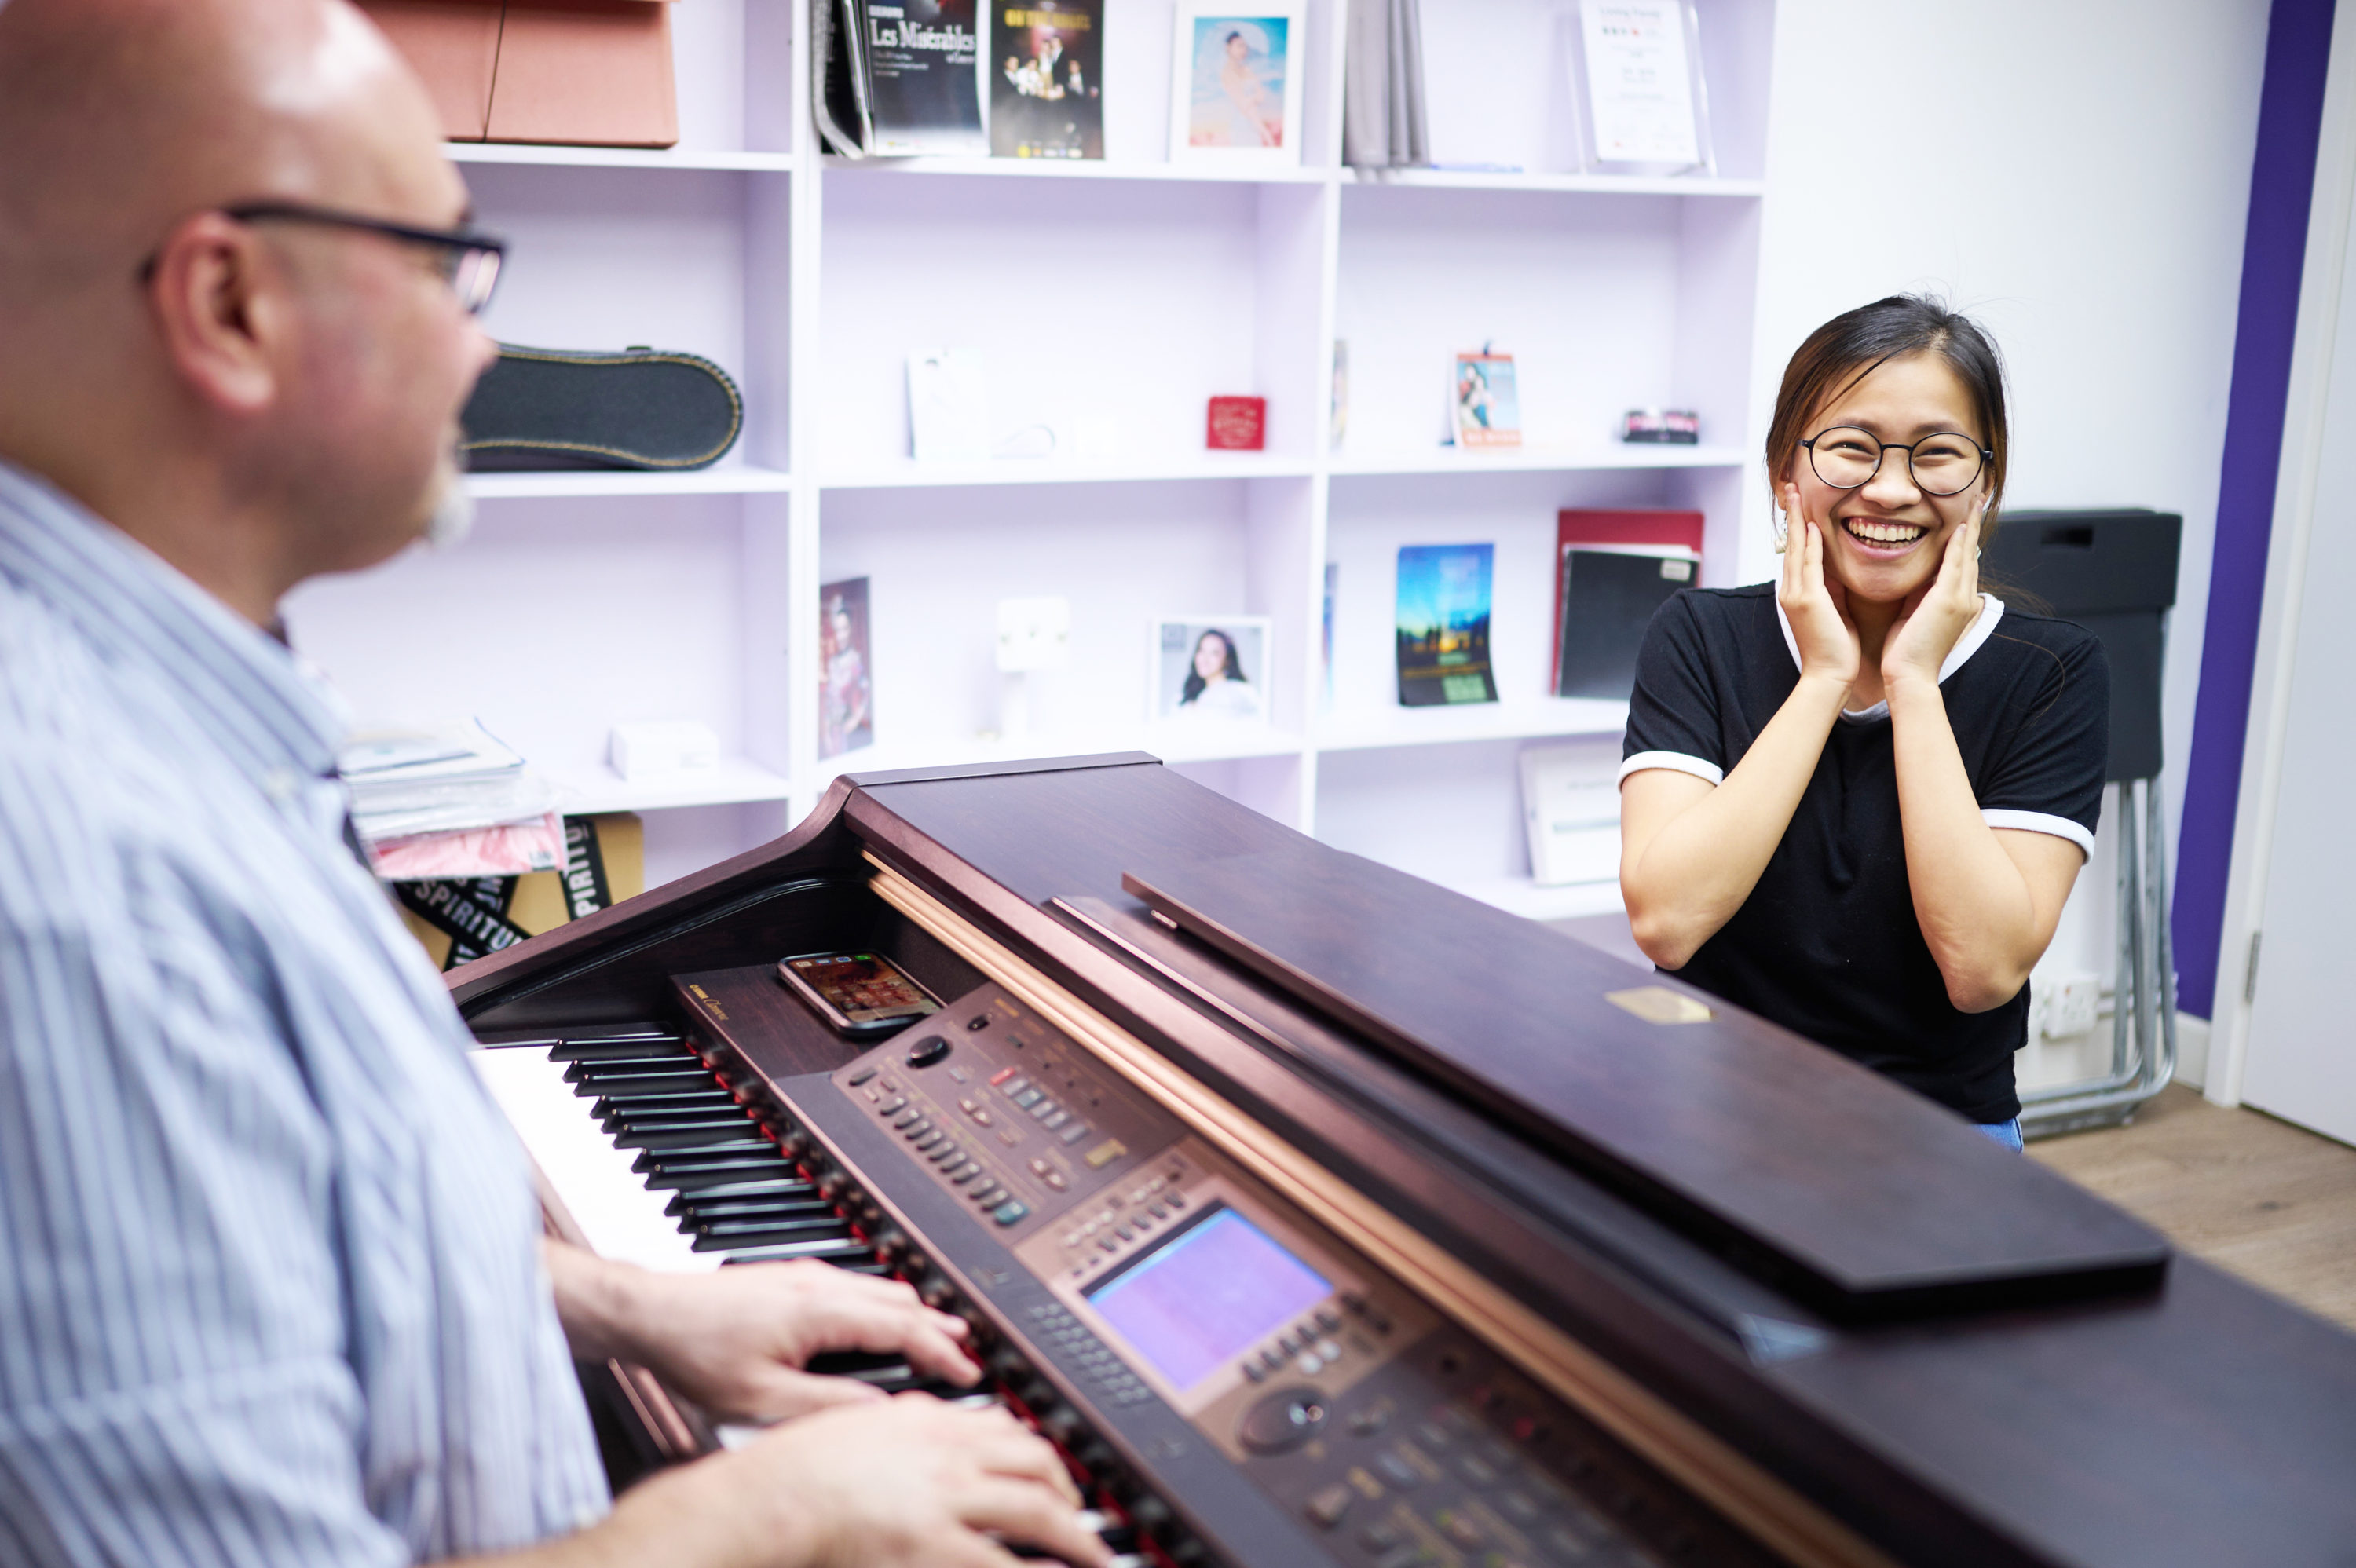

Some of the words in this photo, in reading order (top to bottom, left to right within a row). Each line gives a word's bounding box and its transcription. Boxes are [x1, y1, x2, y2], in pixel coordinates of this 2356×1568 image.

[869, 19, 898, 47] Les
[898, 20, 975, 51] Misérables
[414, 877, 524, 952] SPIRITU
